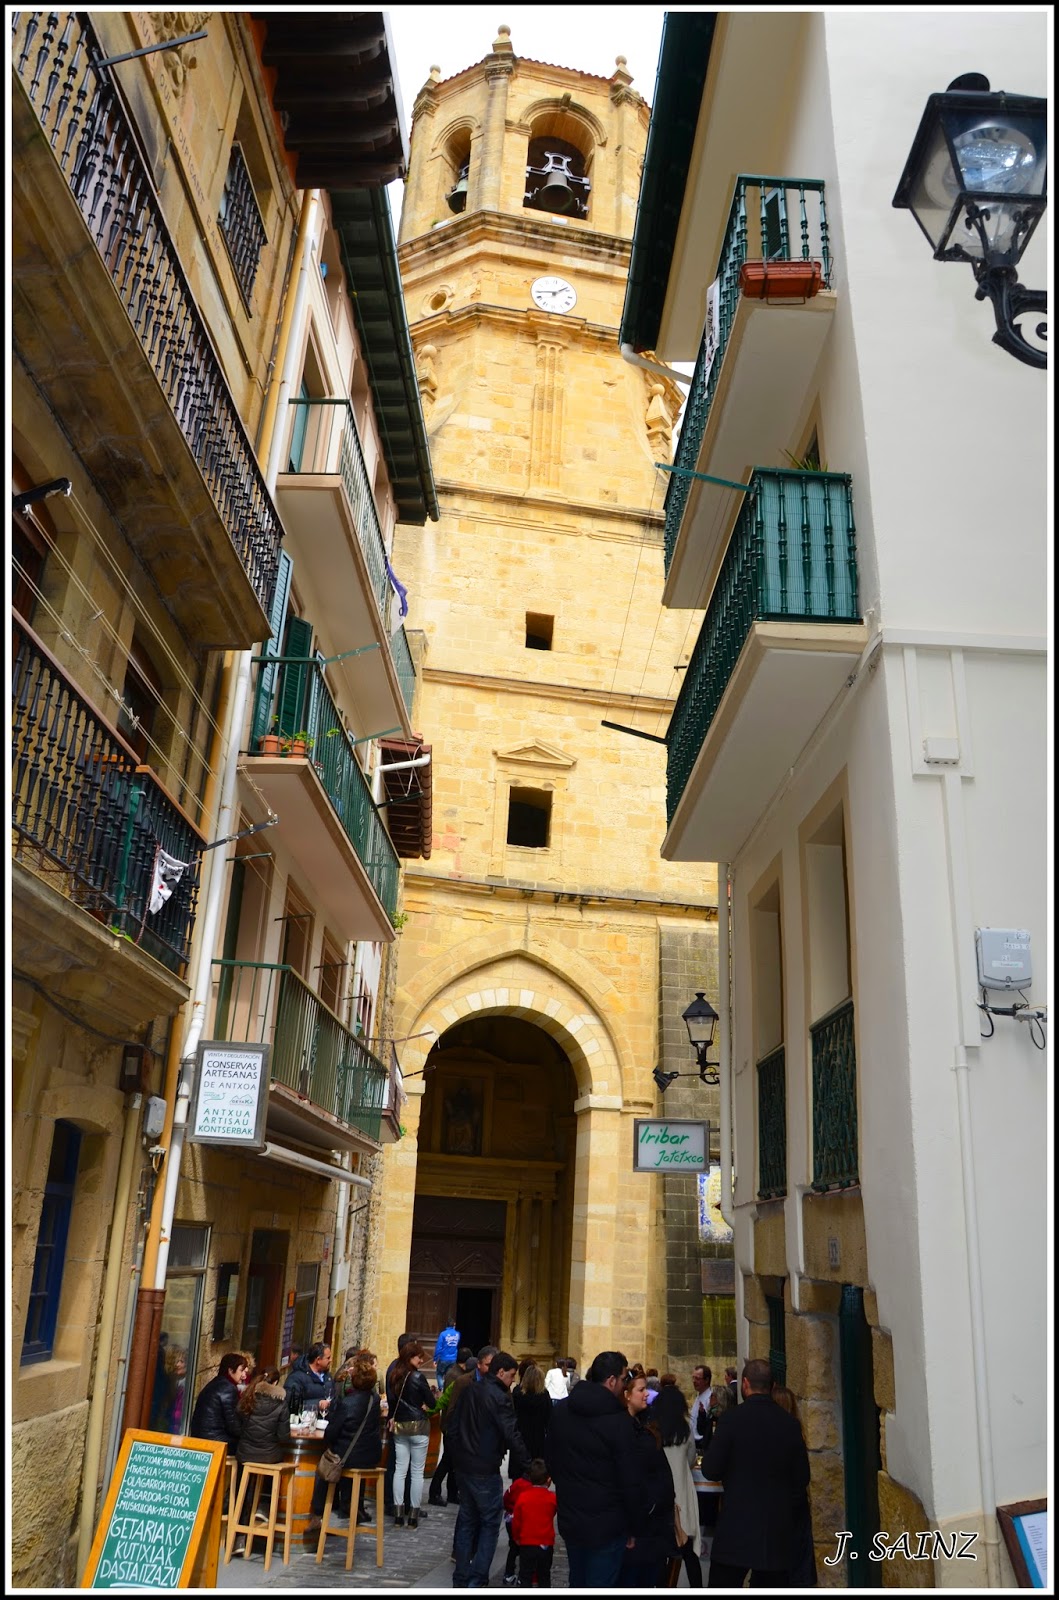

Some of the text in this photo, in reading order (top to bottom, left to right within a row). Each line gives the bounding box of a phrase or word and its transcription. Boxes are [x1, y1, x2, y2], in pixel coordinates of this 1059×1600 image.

[206, 1060, 257, 1071] CONSERVAS
[204, 1069, 258, 1080] ARTESANAS
[218, 1082, 257, 1091] ANTXOA
[203, 1108, 250, 1118] ANTXUA
[203, 1116, 249, 1126] ARTISAU
[198, 1125, 253, 1135] KONTSERBAK
[640, 1125, 690, 1145] Iribar
[114, 1540, 177, 1566] KUTIXIAK
[100, 1559, 181, 1587] DASTAITZAZU
